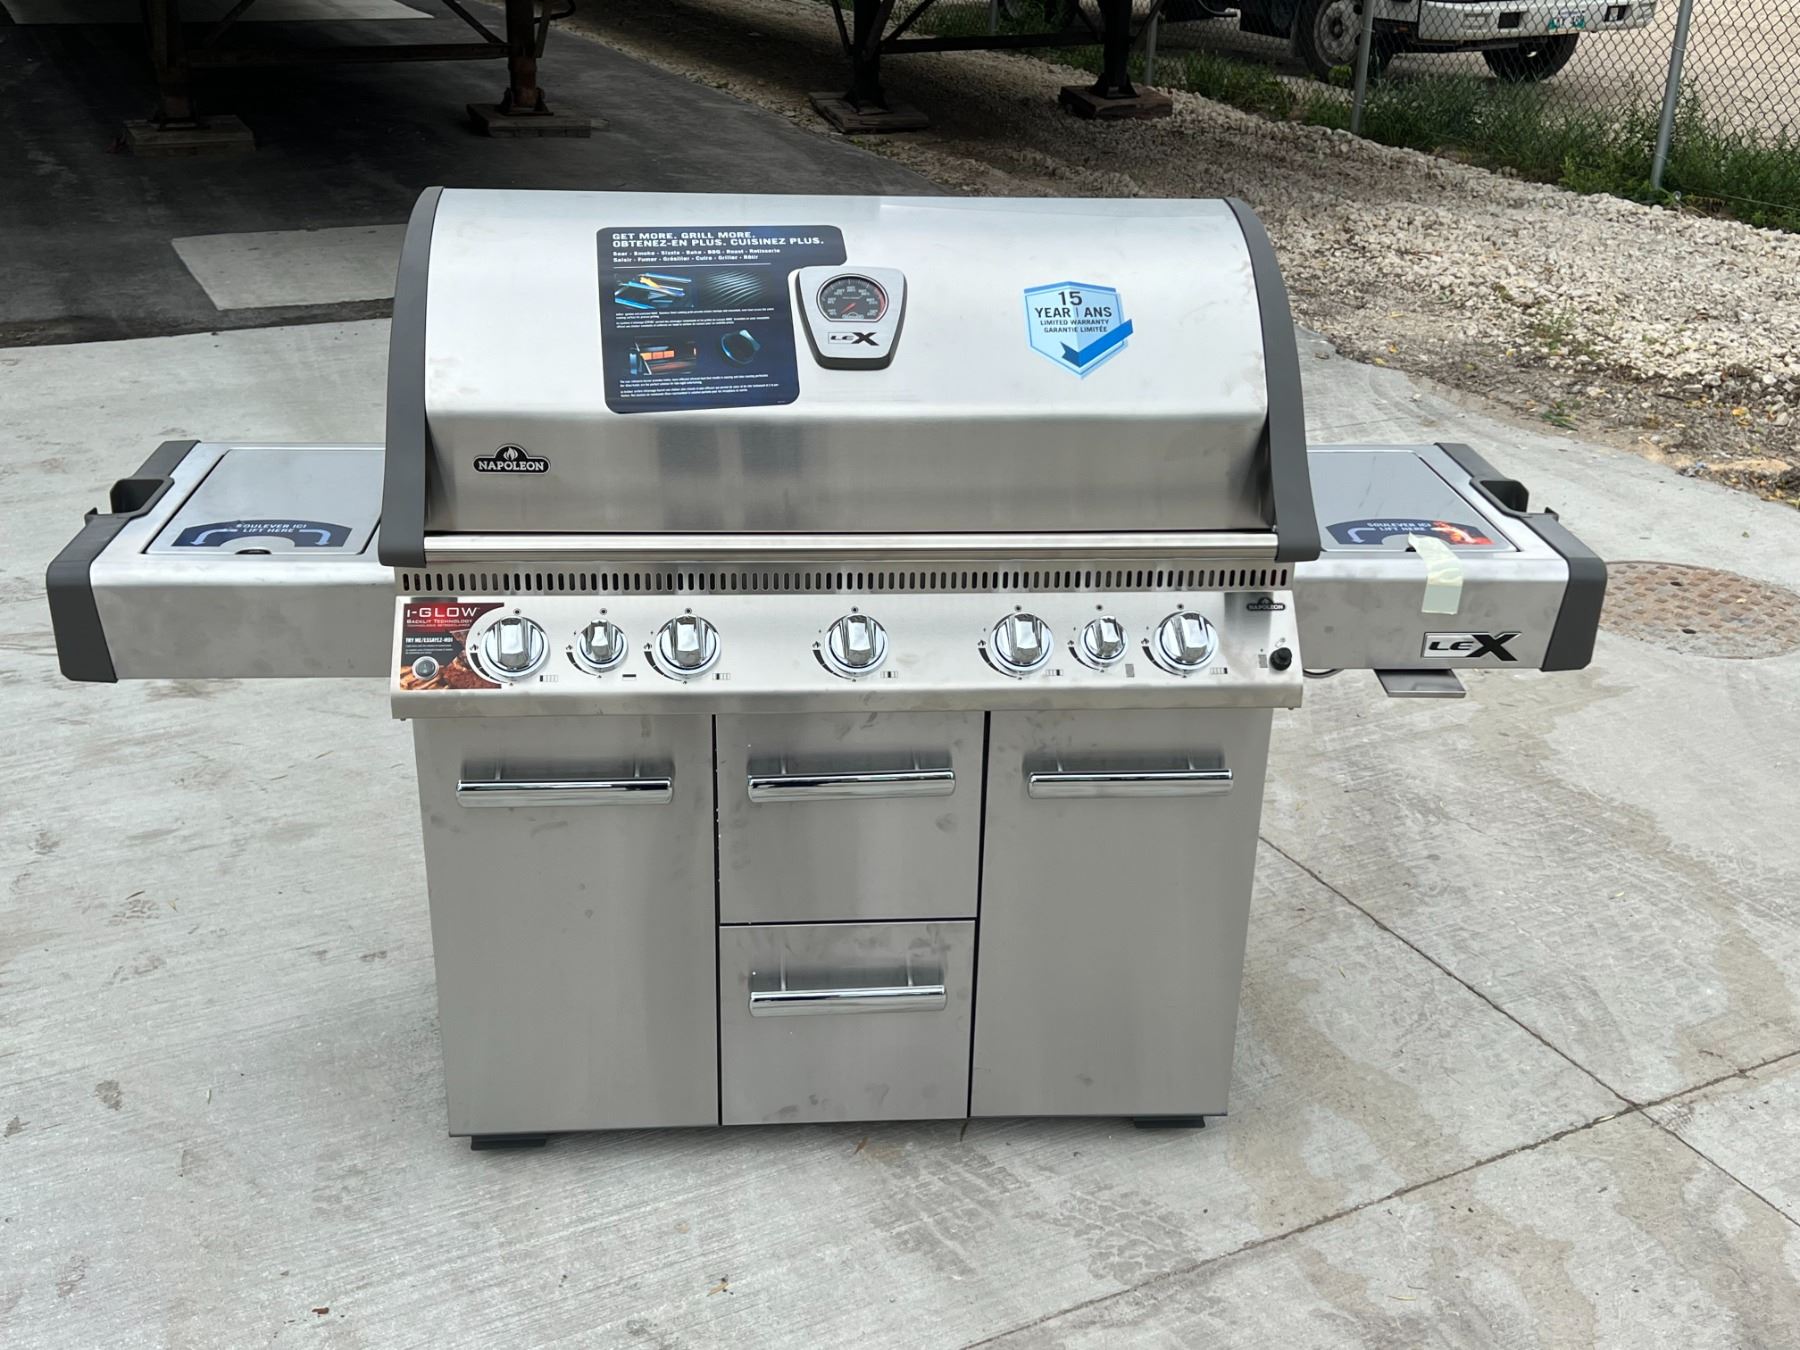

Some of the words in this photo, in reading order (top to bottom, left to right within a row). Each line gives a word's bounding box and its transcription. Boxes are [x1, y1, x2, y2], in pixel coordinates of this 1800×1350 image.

[639, 232, 677, 240] MORE.
[718, 231, 756, 239] MORE.
[612, 239, 688, 248] OBTENEZ-EN
[691, 239, 727, 247] PLUS.
[730, 238, 787, 246] CUISINEZ
[789, 237, 825, 245] PLUS.
[1058, 291, 1083, 306] 15
[1034, 307, 1072, 318] YEAR
[1084, 306, 1112, 318] ANS
[1080, 325, 1108, 333] LIMITÉE
[478, 460, 545, 471] NAPOLEON
[1428, 634, 1520, 662] LEX
